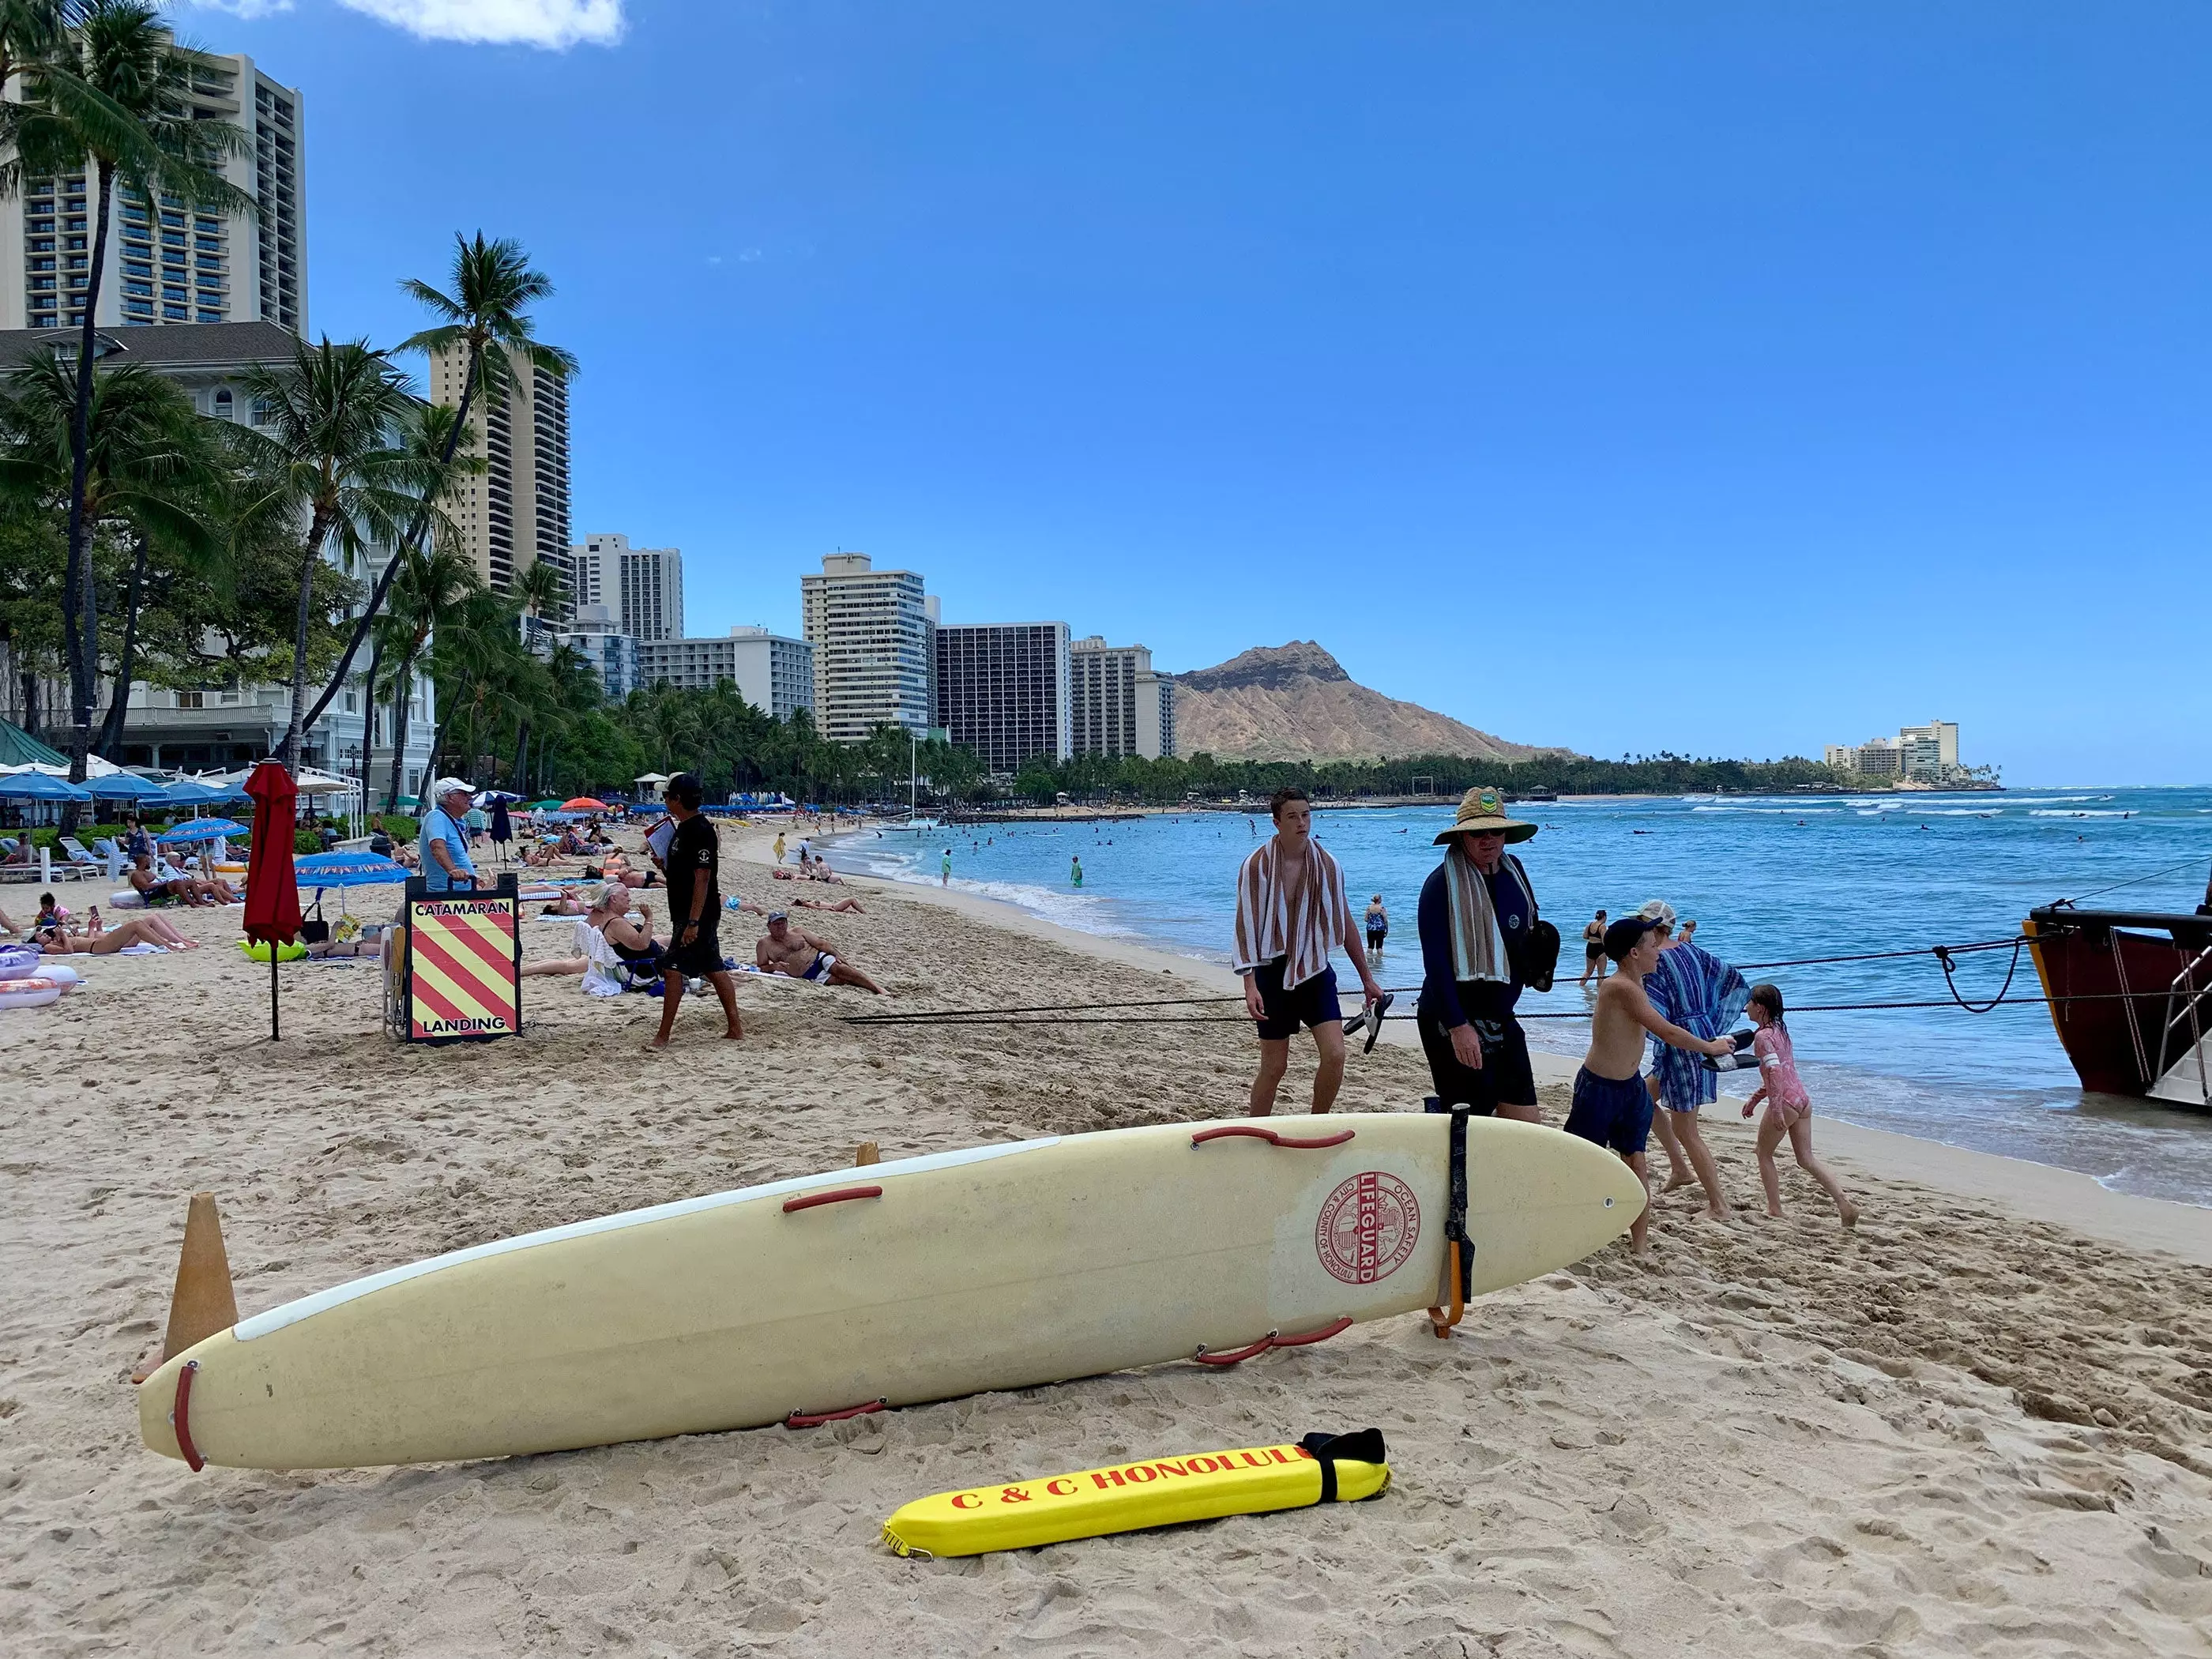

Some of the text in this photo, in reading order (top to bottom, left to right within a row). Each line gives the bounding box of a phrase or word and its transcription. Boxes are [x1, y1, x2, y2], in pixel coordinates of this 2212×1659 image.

[415, 901, 510, 916] CATAMARAN
[423, 1017, 506, 1033] LANDING
[1339, 1183, 1354, 1197] CITY
[1319, 1203, 1335, 1237] COUNTY
[1360, 1174, 1376, 1282] LIFEGUARD
[1394, 1185, 1416, 1265] OCEAN SAFETY
[1319, 1238, 1328, 1249] OF
[1322, 1251, 1353, 1279] HONOLULU
[951, 1493, 984, 1509] C
[1000, 1487, 1033, 1503] &
[1047, 1479, 1078, 1495] C
